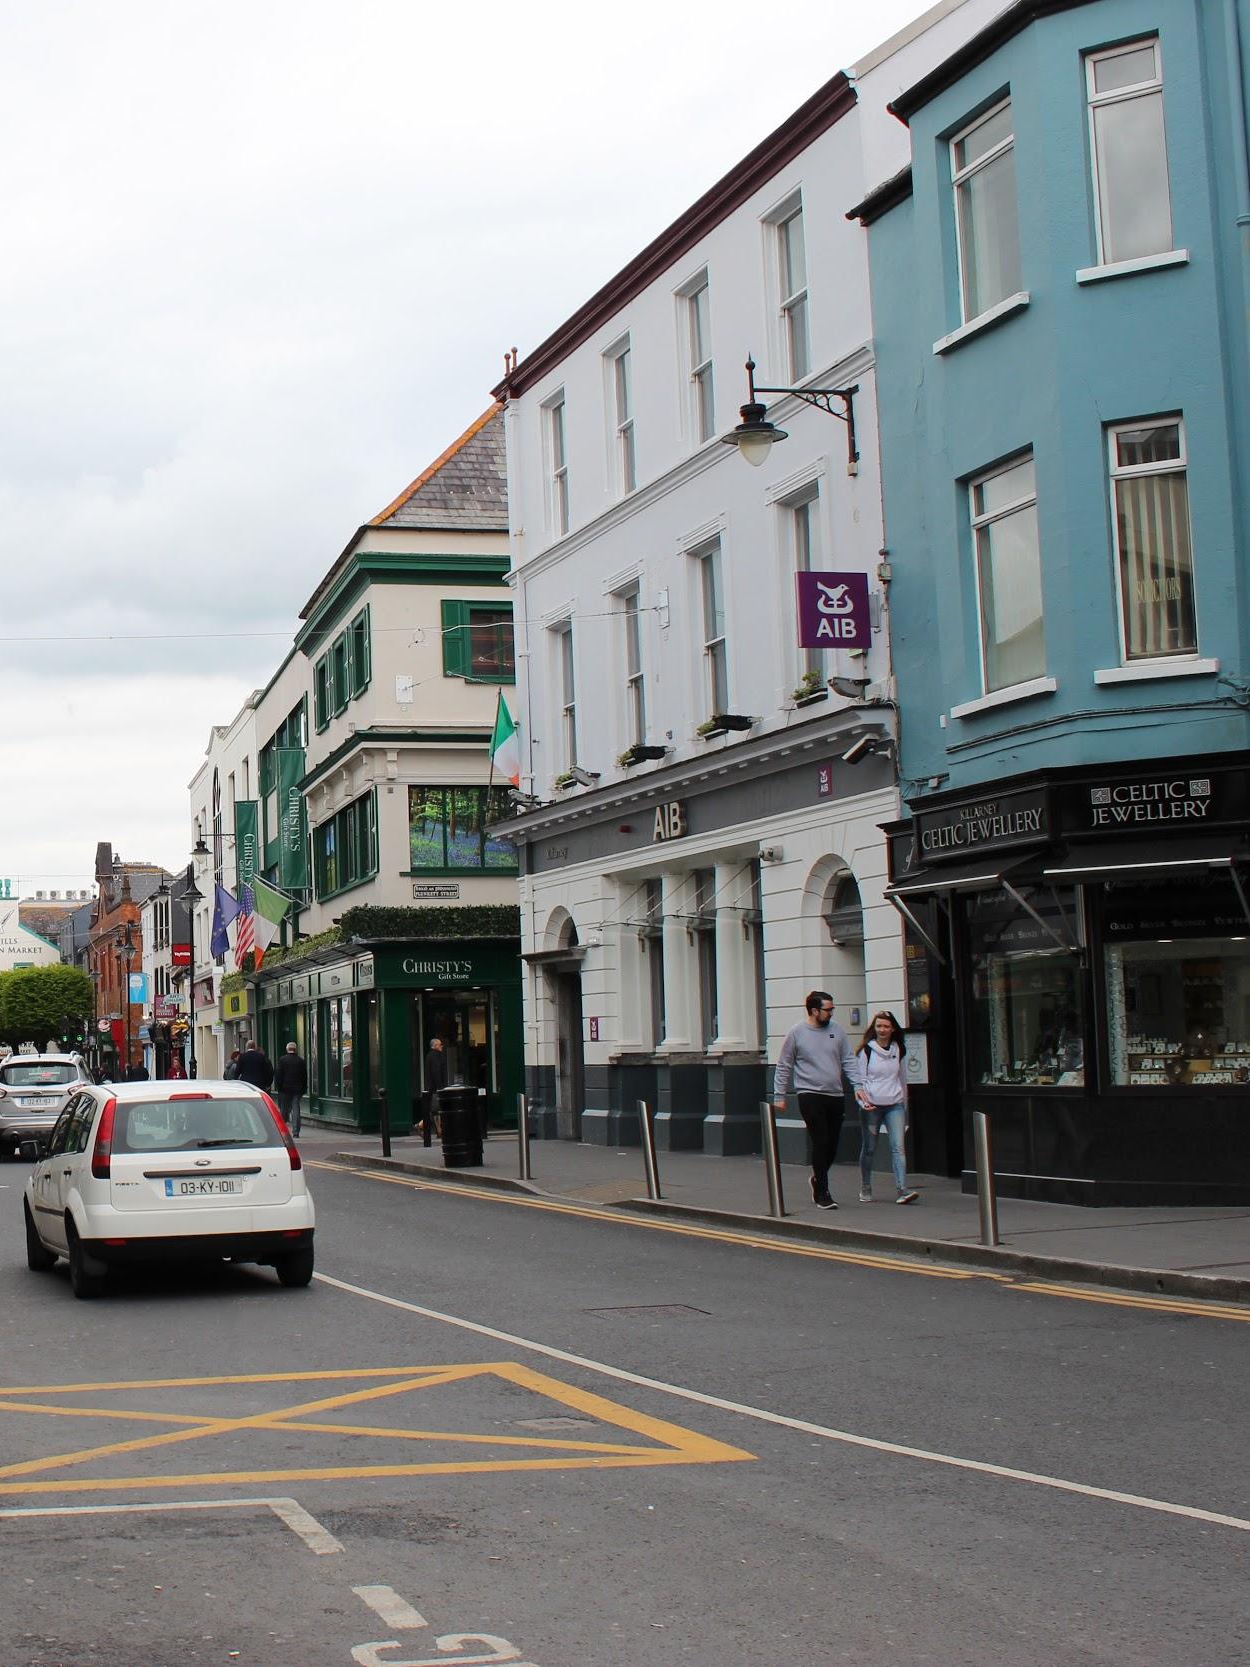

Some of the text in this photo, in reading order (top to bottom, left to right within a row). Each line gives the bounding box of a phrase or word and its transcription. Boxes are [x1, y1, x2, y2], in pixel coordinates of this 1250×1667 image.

[816, 618, 857, 638] AIB
[1113, 781, 1185, 803] CELTIC
[288, 786, 302, 852] CHRISTY'S
[653, 802, 682, 841] AIB
[959, 803, 998, 821] KILLARNEY
[1092, 800, 1211, 827] JEWELLERY
[921, 808, 1042, 850] CELTIC JEWELLERY
[7, 946, 43, 954] MARKET
[402, 958, 472, 974] CHRISTY'S
[180, 1180, 235, 1194] 03-KY-1011
